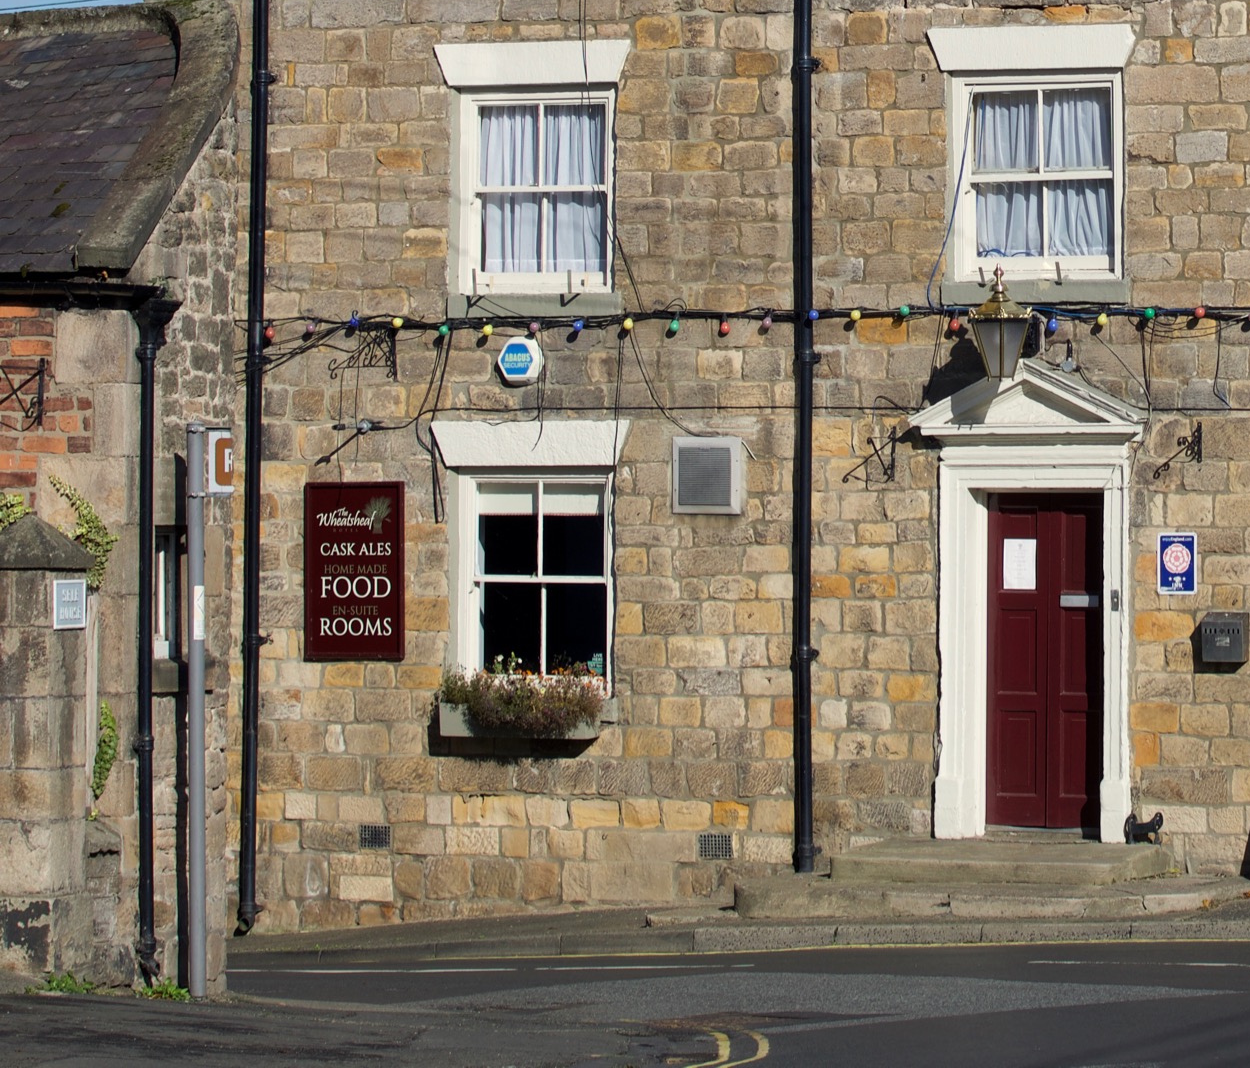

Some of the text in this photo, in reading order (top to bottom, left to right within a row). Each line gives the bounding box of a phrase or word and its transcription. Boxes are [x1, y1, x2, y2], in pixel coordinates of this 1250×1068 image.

[505, 353, 531, 362] ABACUS
[337, 506, 349, 516] The
[316, 510, 377, 530] Wheatsheaf
[320, 542, 392, 556] CASK ALES
[324, 564, 388, 574] HOME MADE
[320, 576, 391, 598] FOOD
[60, 606, 82, 620] HOUSE
[332, 605, 379, 616] EN-SUITE
[319, 617, 392, 636] ROOMS
